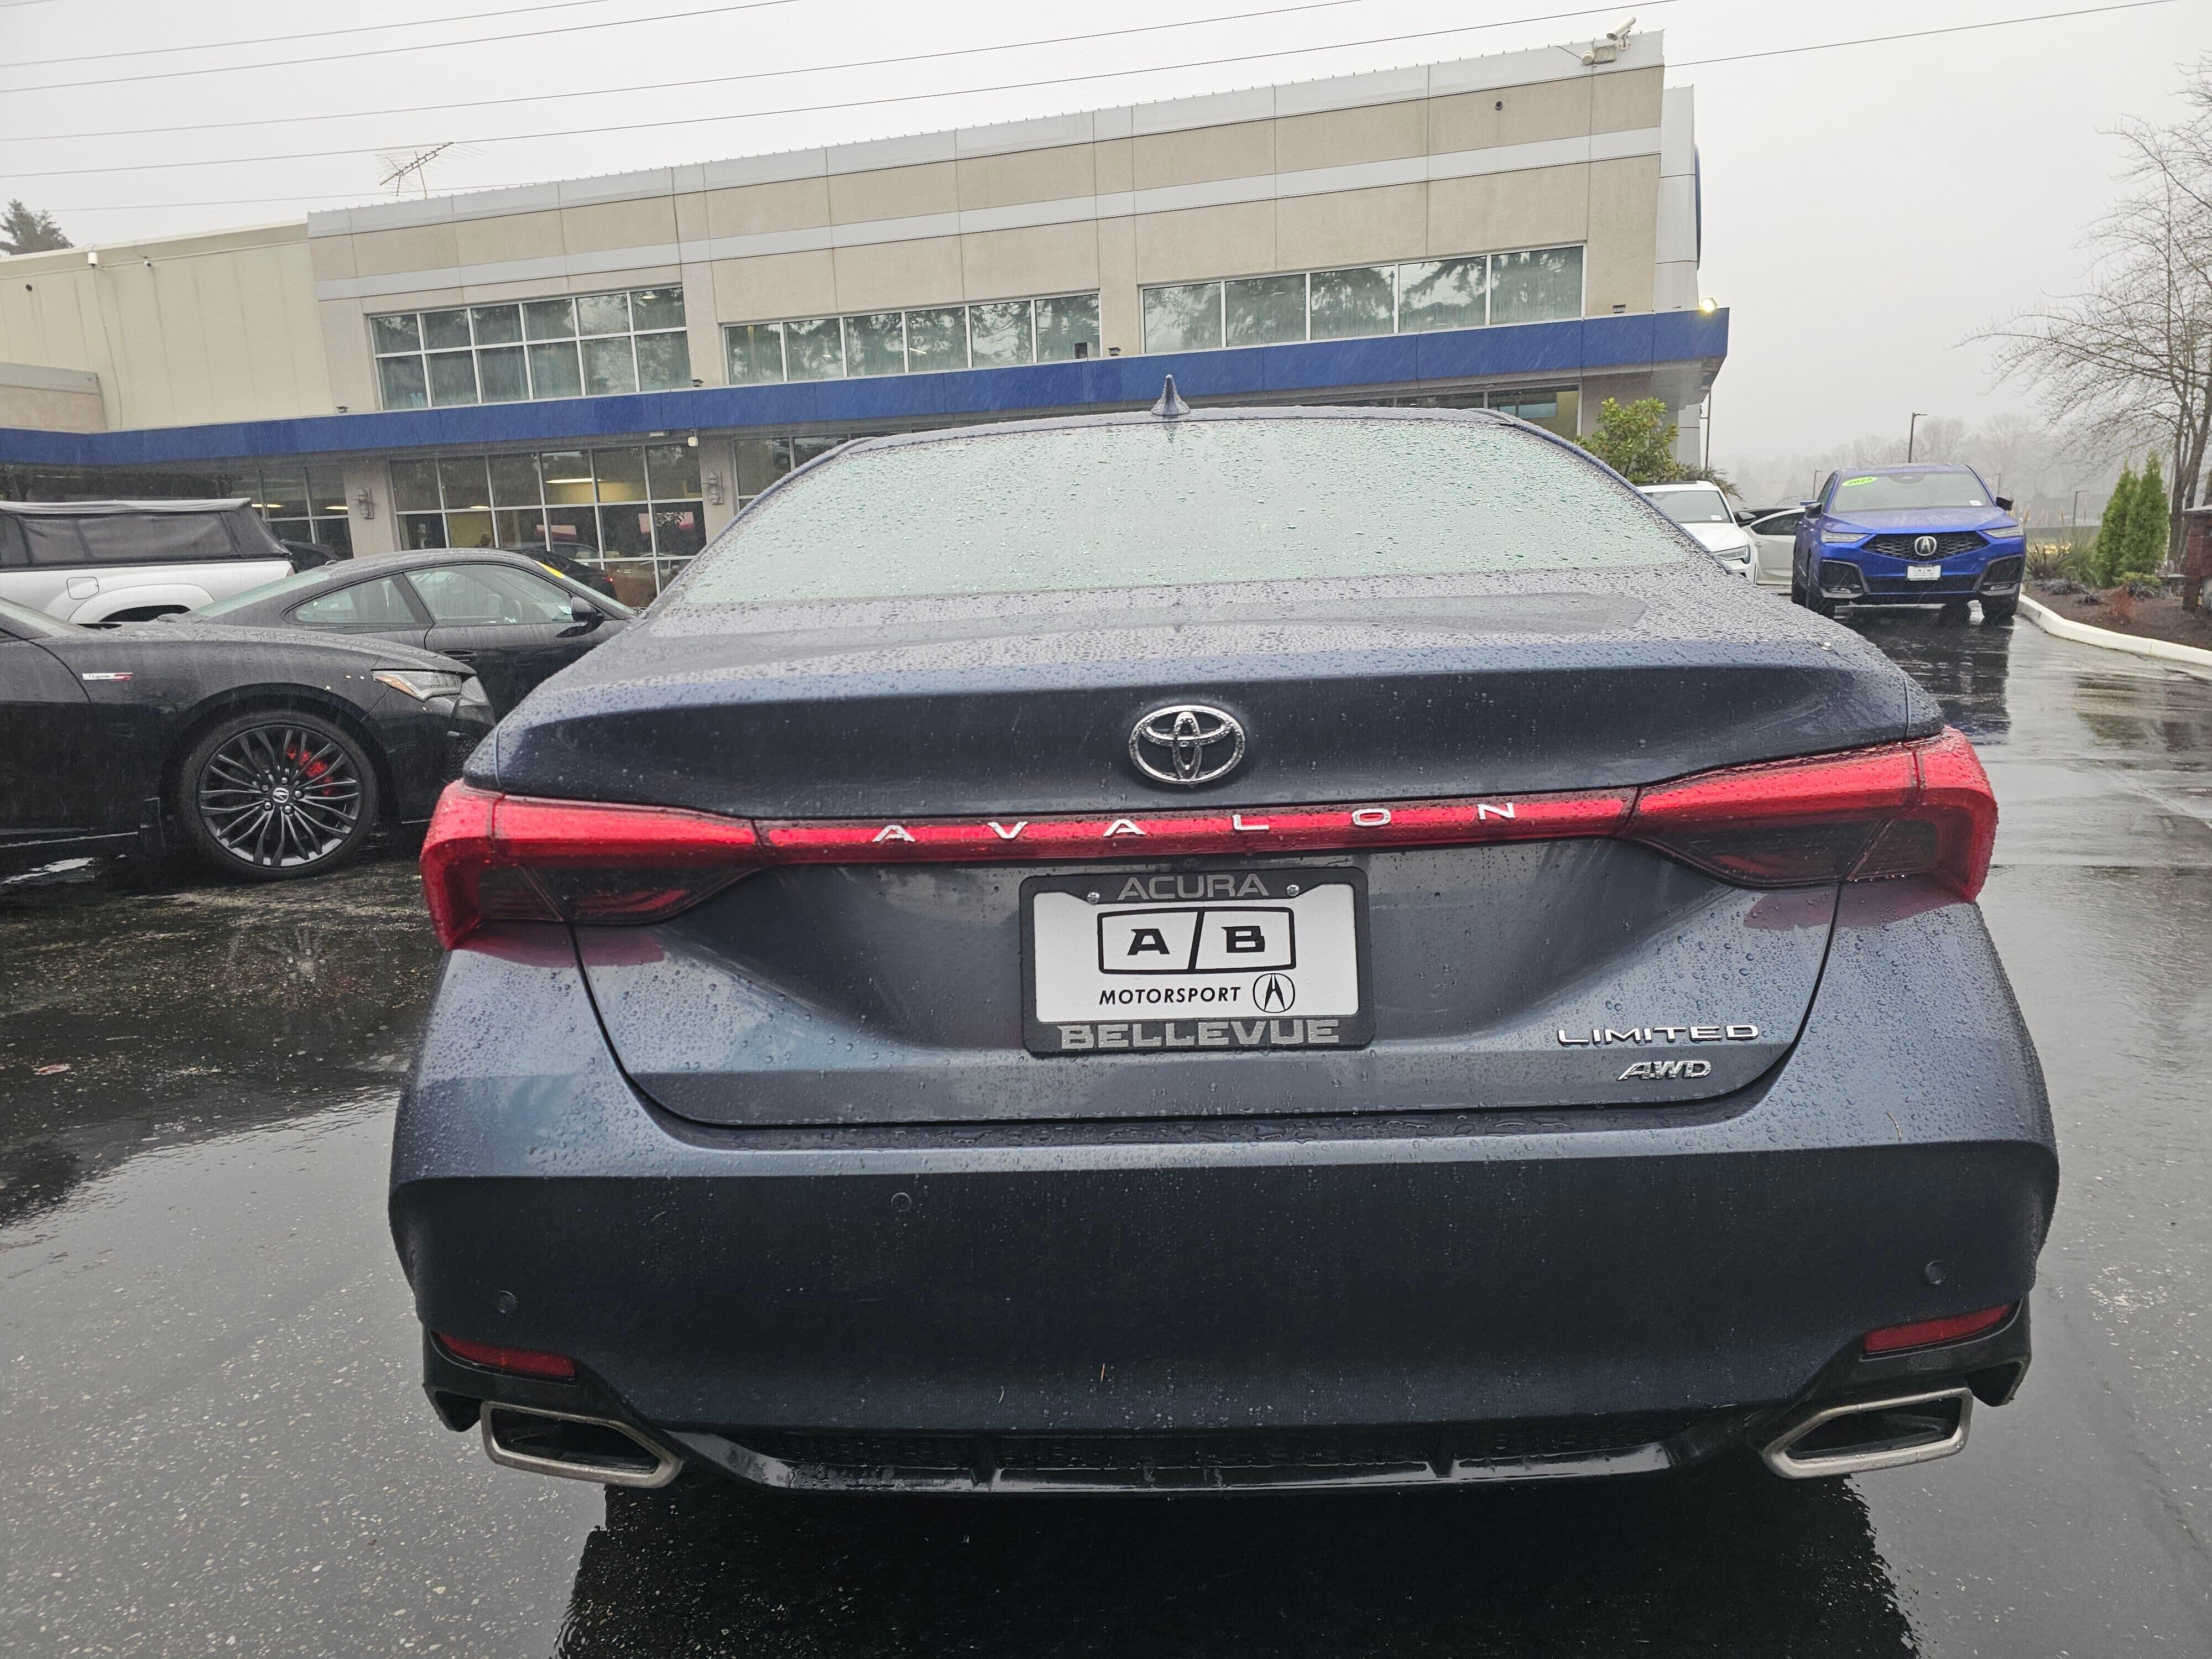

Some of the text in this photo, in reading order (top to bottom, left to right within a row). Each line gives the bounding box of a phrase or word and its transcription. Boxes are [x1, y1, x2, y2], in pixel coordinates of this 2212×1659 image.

[872, 802, 1515, 842] AVALON
[1117, 874, 1270, 901] ACURA
[1126, 925, 1265, 956] A B
[1099, 986, 1241, 1005] MOTORSPORT
[1057, 1019, 1339, 1050] BELLEVUE
[1557, 1025, 1759, 1044] LIMITED
[1618, 1060, 1712, 1081] AWD
